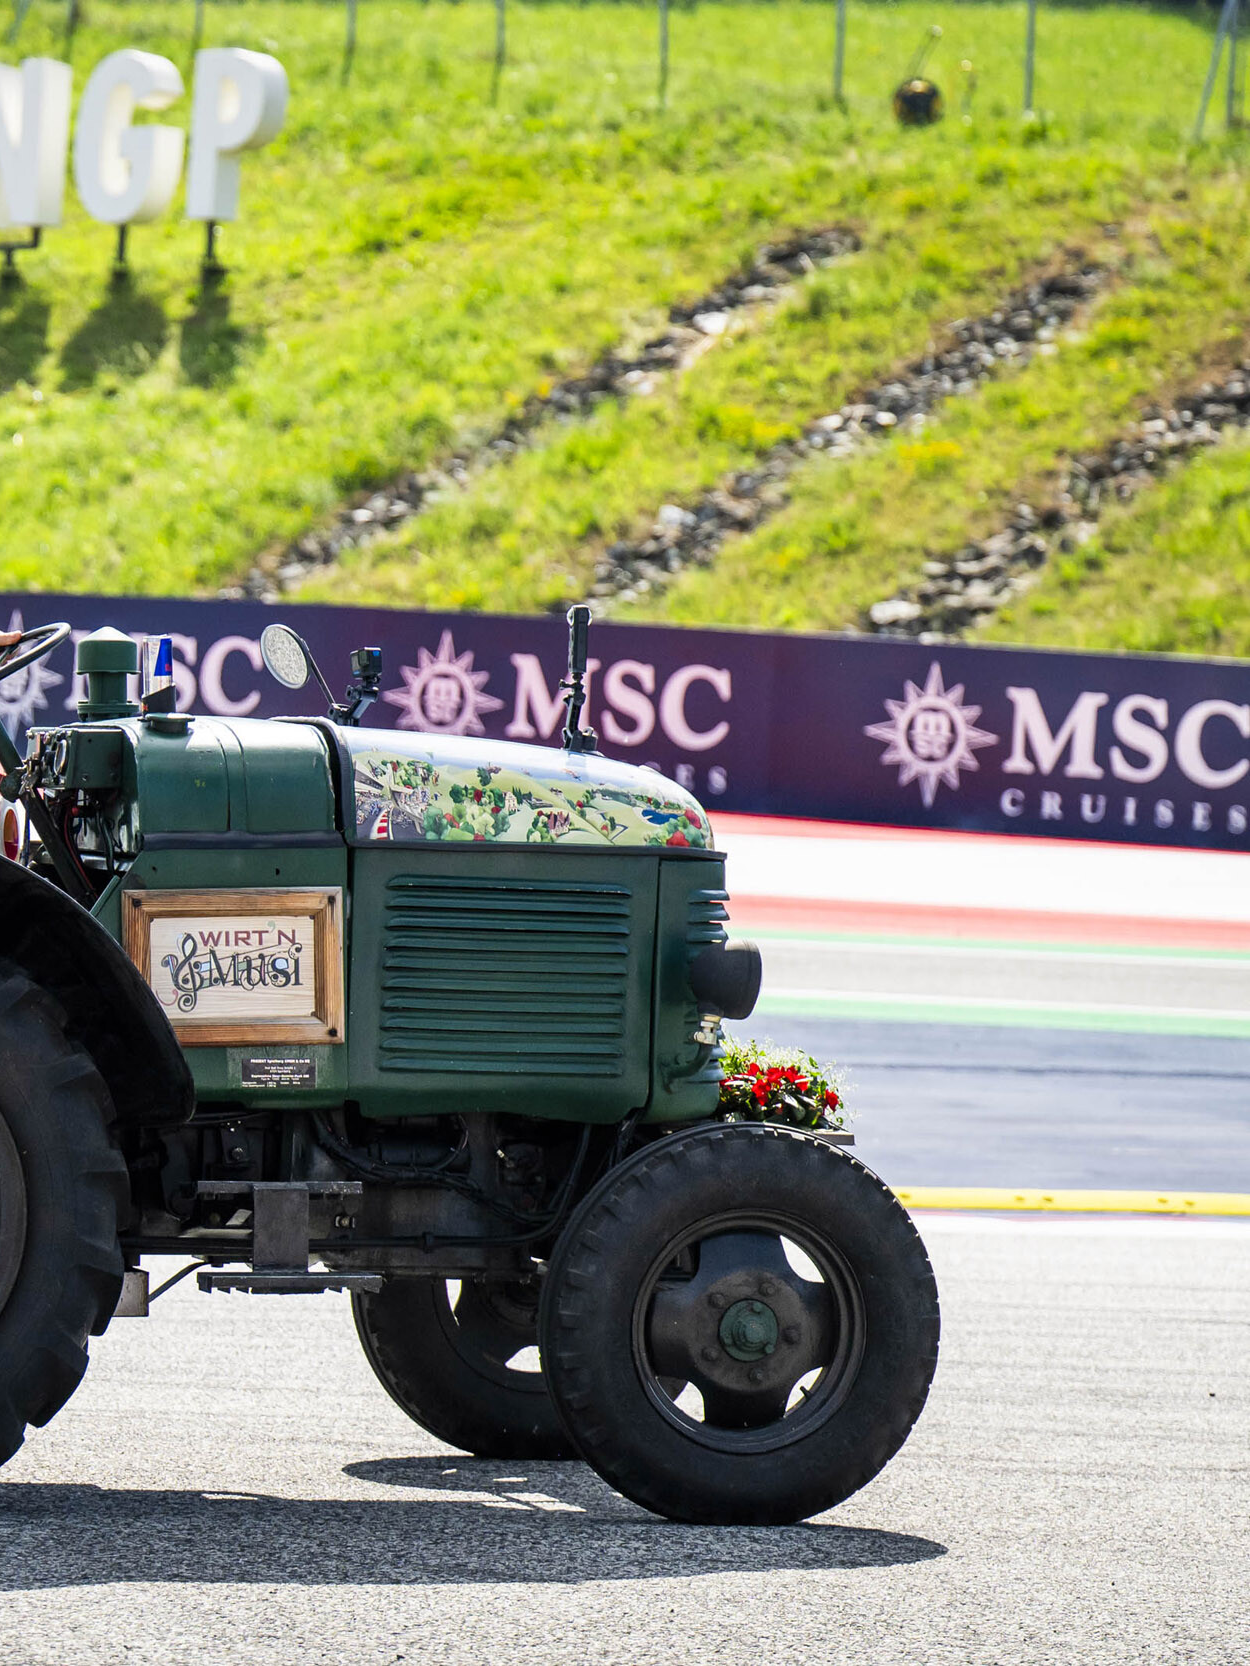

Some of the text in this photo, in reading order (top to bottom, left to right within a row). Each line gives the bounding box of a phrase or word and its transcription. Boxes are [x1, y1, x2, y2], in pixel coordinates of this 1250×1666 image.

[505, 653, 732, 752] MSC
[1001, 685, 1250, 790] MSC
[1000, 788, 1249, 835] CRUISES
